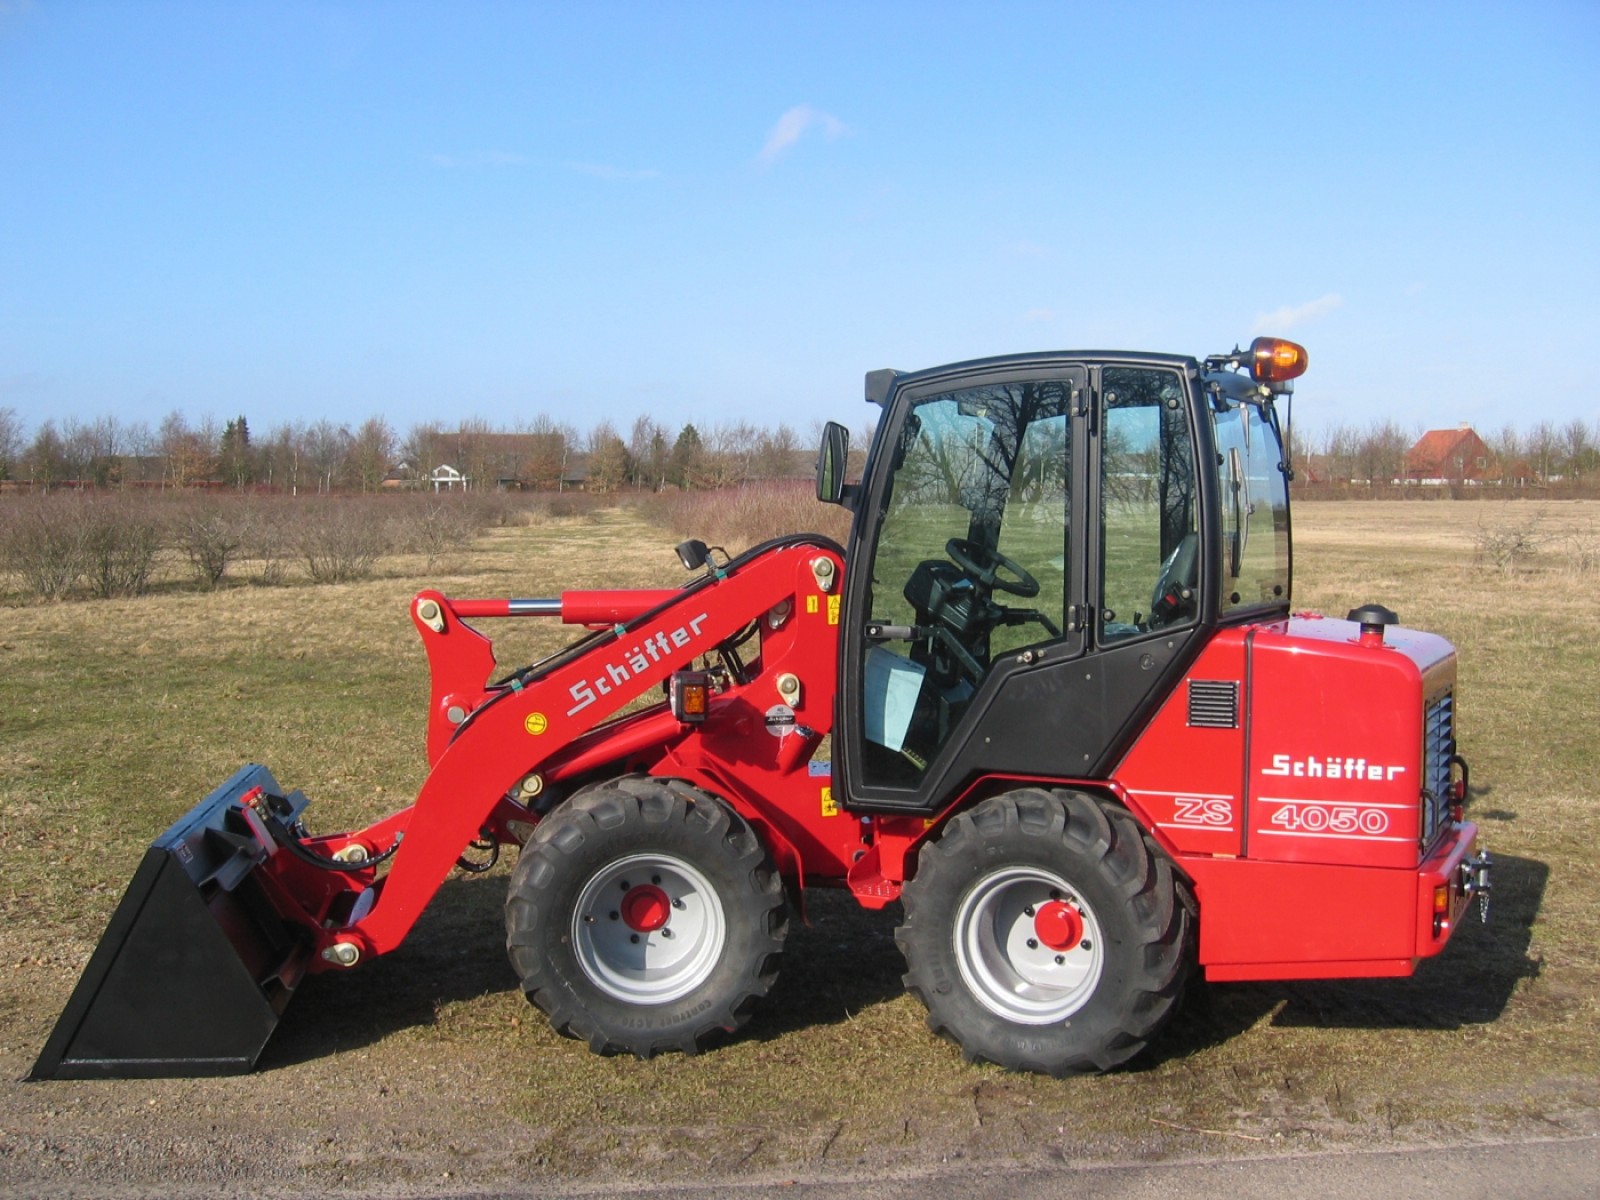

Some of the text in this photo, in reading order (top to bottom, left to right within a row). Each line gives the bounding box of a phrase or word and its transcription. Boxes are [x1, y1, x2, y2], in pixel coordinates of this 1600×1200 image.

[567, 612, 708, 717] Schäffer
[1261, 754, 1405, 781] Schäffer
[1173, 797, 1389, 834] ZS 4050
